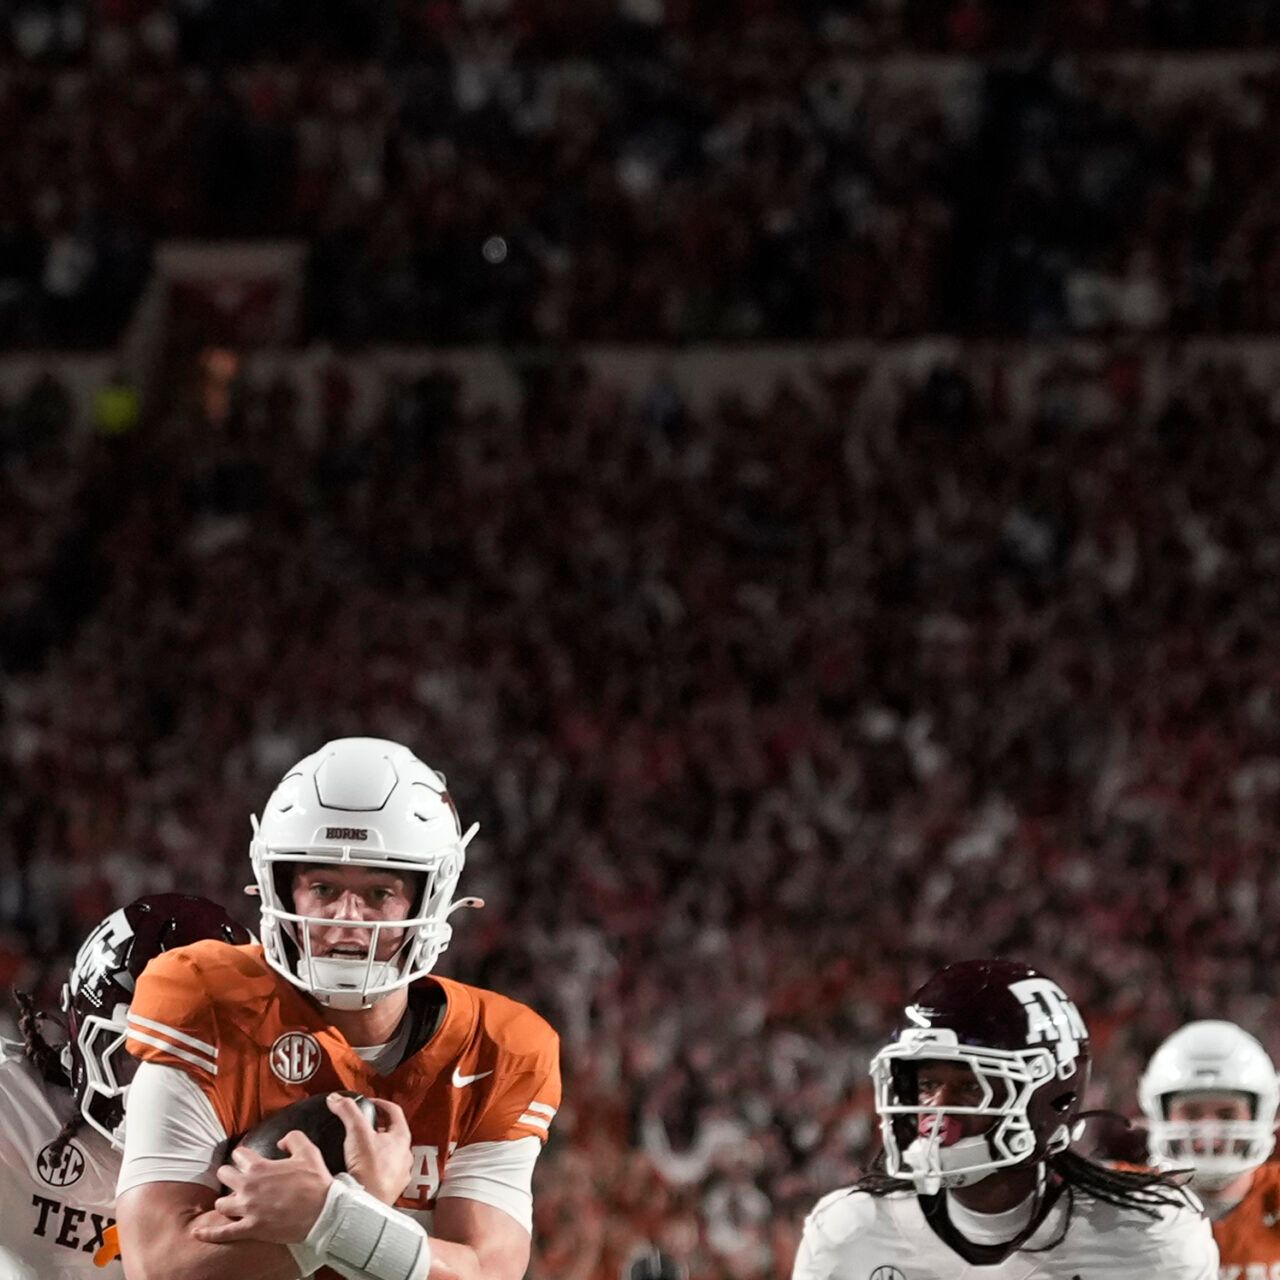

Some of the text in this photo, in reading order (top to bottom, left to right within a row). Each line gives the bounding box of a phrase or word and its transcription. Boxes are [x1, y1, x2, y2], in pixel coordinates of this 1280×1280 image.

[325, 827, 368, 841] HORNS
[269, 1031, 322, 1084] SEC
[32, 1194, 121, 1261] TEX
